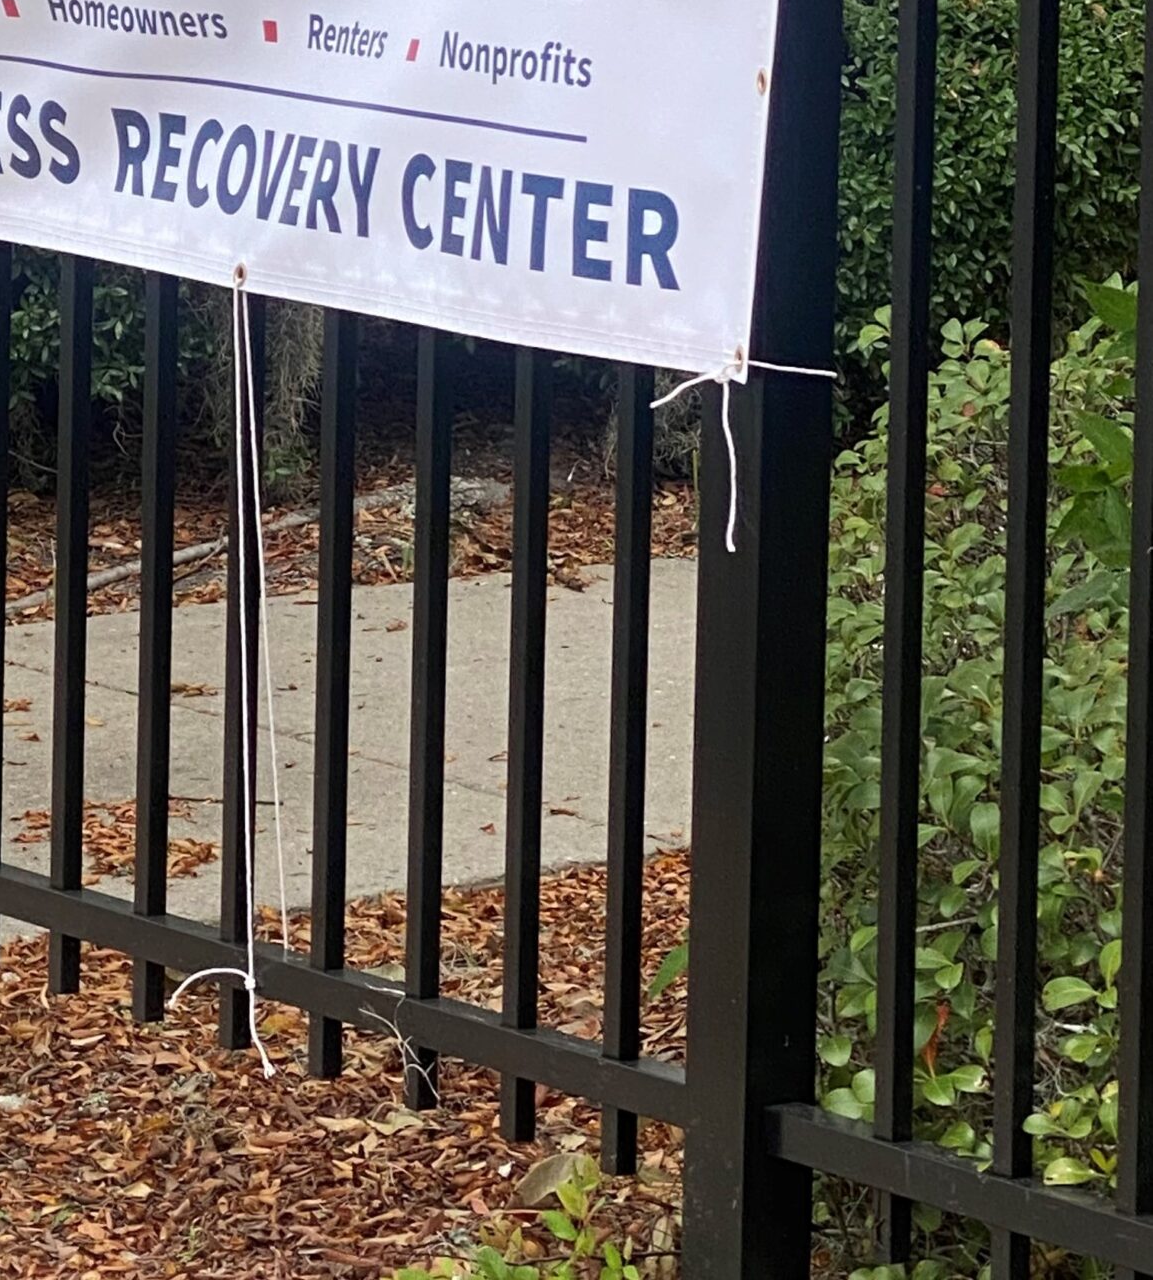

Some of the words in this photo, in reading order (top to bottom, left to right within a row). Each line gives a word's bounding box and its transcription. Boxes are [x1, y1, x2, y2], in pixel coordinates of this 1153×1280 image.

[307, 13, 388, 60] Renters
[439, 30, 592, 89] Nonprofits
[110, 107, 381, 239] RECOVERY
[401, 152, 681, 292] CENTER
